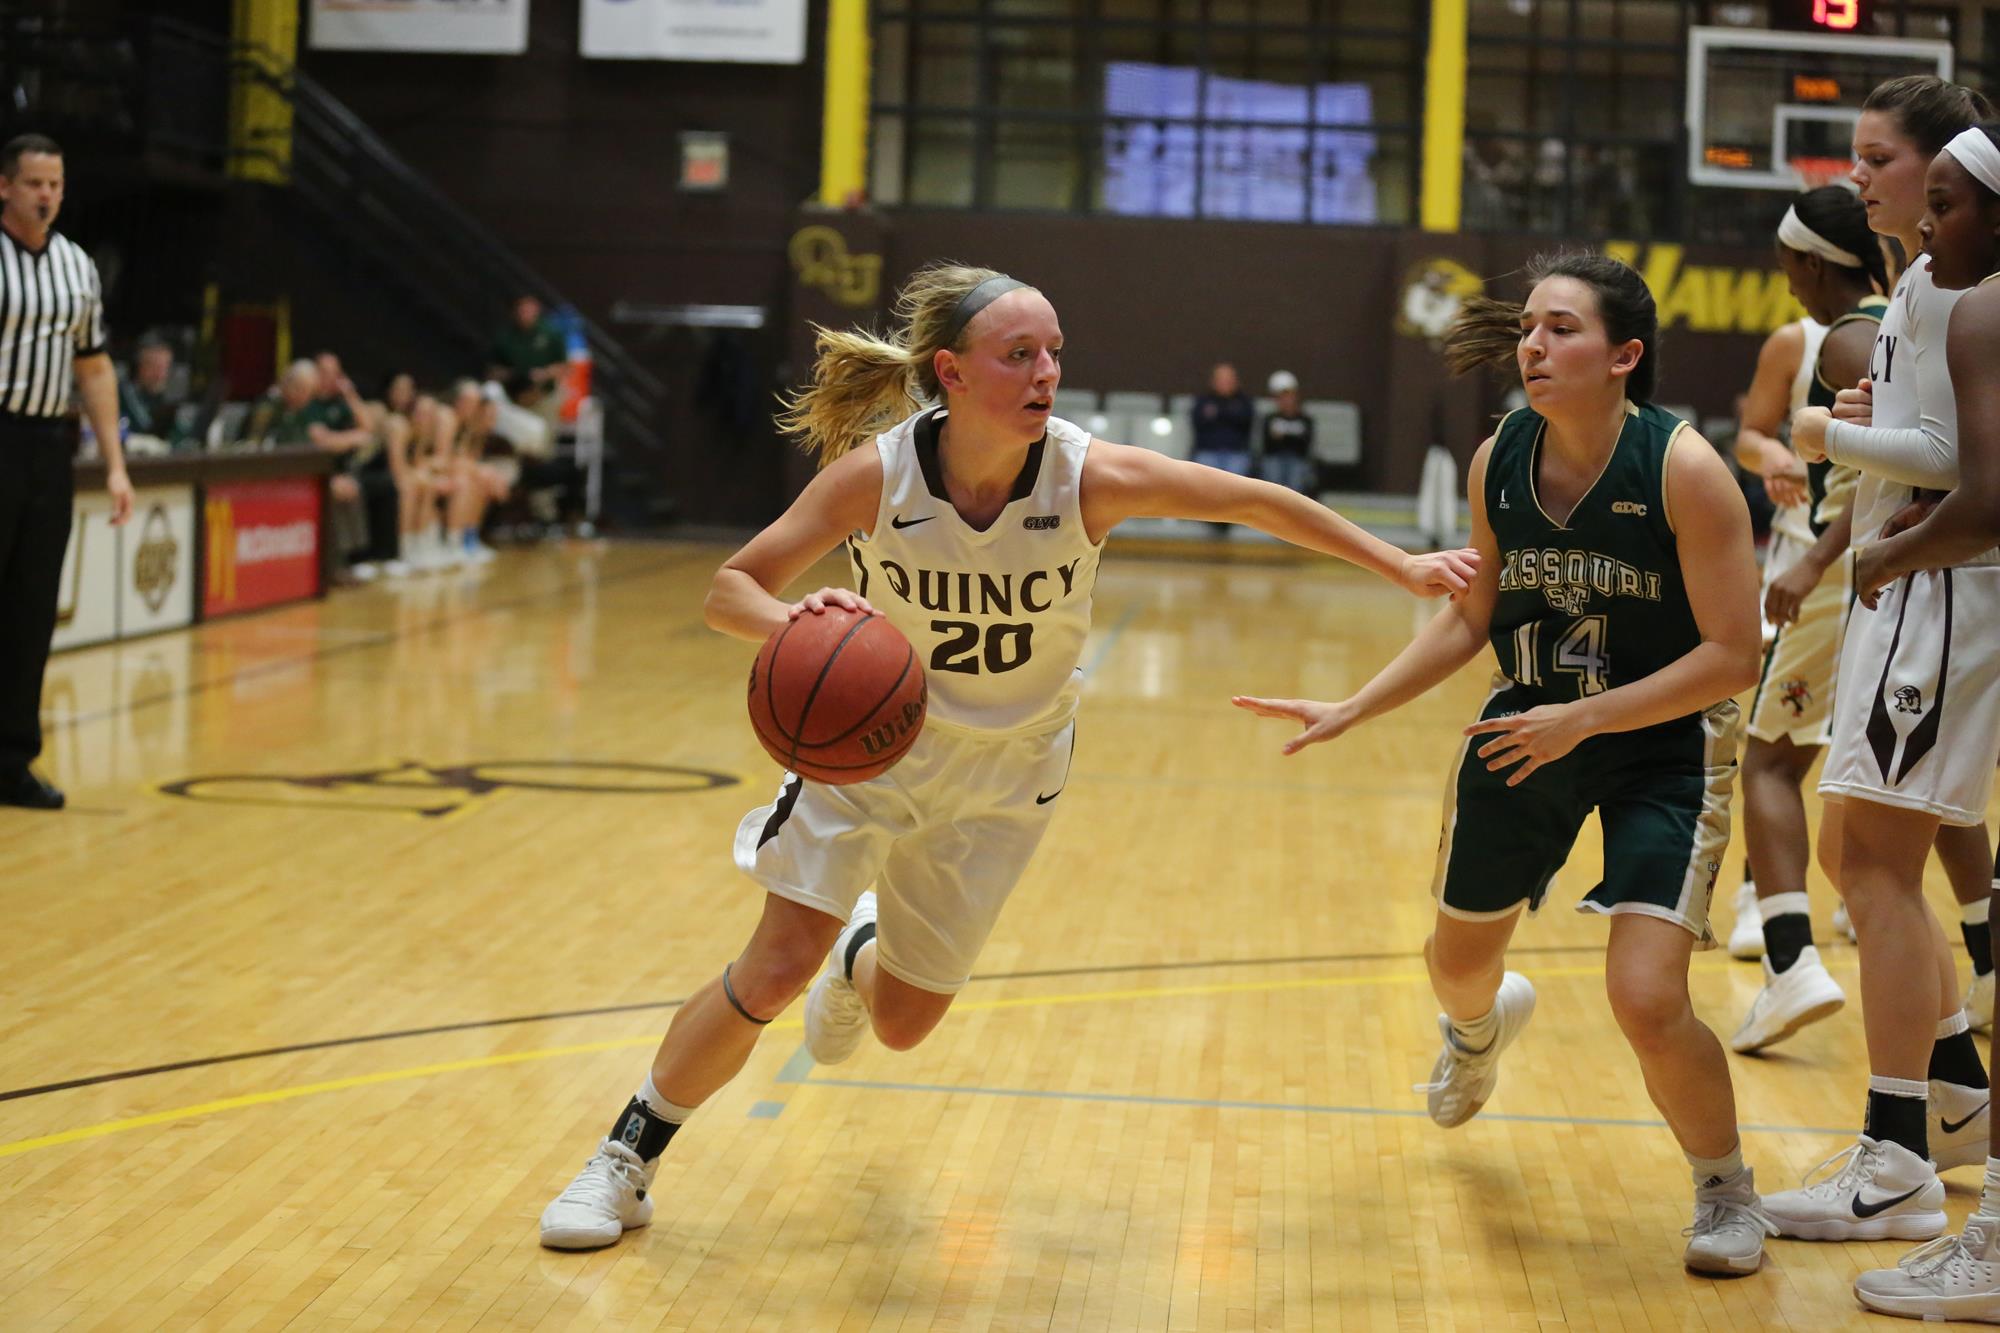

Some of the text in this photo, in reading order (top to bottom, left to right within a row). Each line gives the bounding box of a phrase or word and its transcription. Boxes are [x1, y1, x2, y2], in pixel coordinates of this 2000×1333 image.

[1022, 515, 1061, 530] GLVC
[879, 557, 1081, 617] QUINCY
[930, 619, 1034, 675] 20
[1513, 615, 1610, 699] 14
